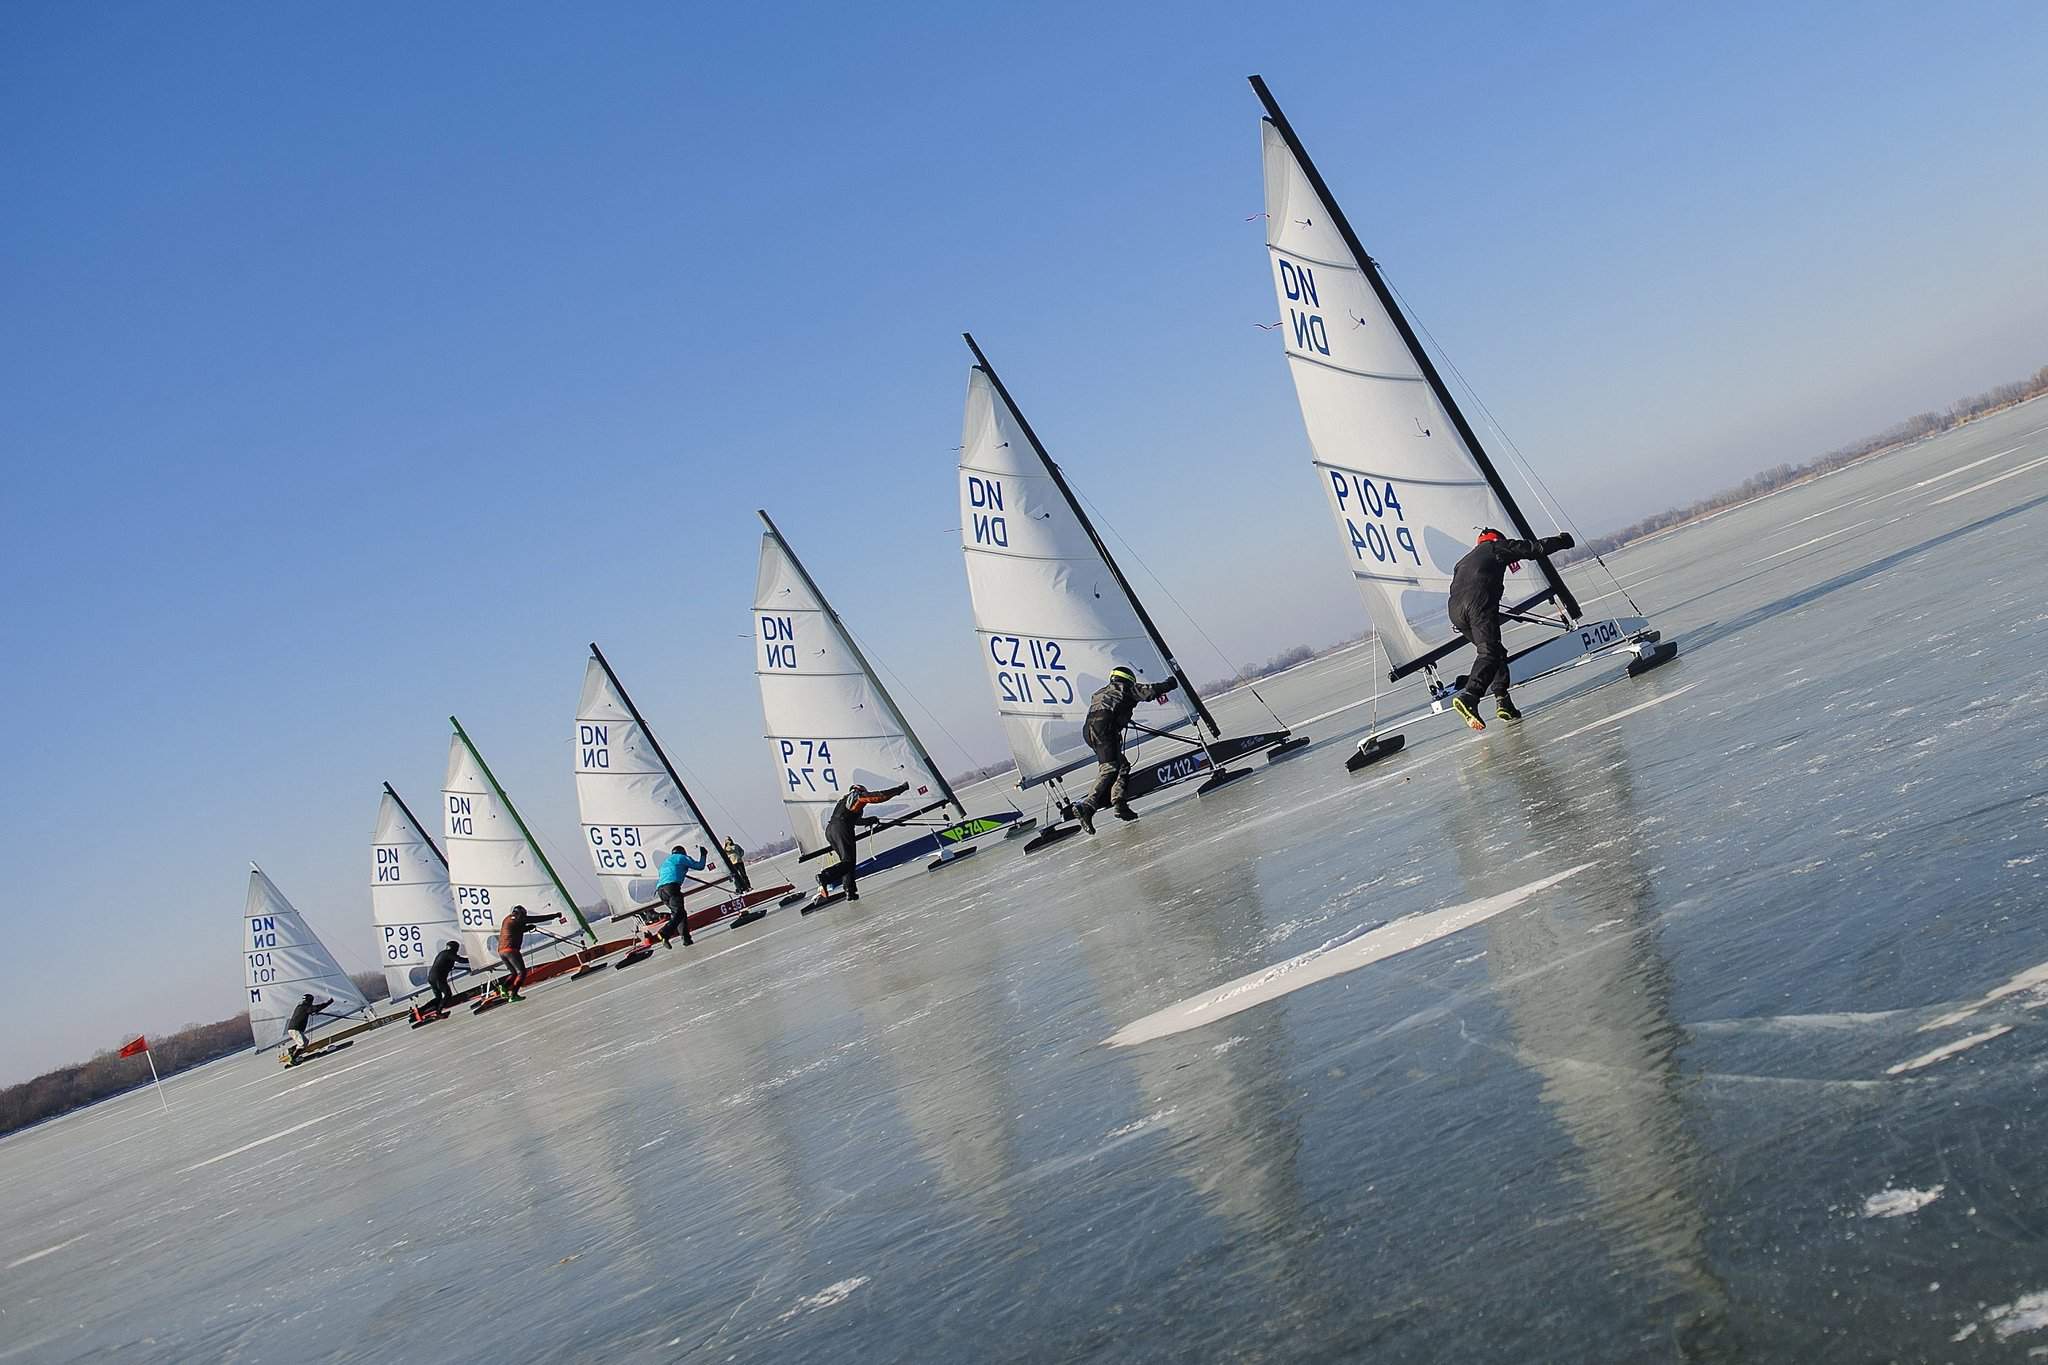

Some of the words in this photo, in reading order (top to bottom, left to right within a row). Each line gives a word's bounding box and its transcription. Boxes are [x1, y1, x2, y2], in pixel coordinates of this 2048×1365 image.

[1279, 259, 1319, 308] DN
[968, 476, 1004, 511] DN
[761, 616, 793, 641] DN
[990, 636, 1026, 668] CZ
[1029, 640, 1067, 671] 112
[580, 725, 608, 746] DN
[800, 740, 832, 765] 74
[449, 796, 471, 815] DN
[610, 827, 642, 847] 551
[376, 847, 399, 864] DN
[458, 886, 491, 906] P58
[251, 916, 275, 932] DN
[248, 952, 272, 969] 101
[250, 988, 262, 1004] M
